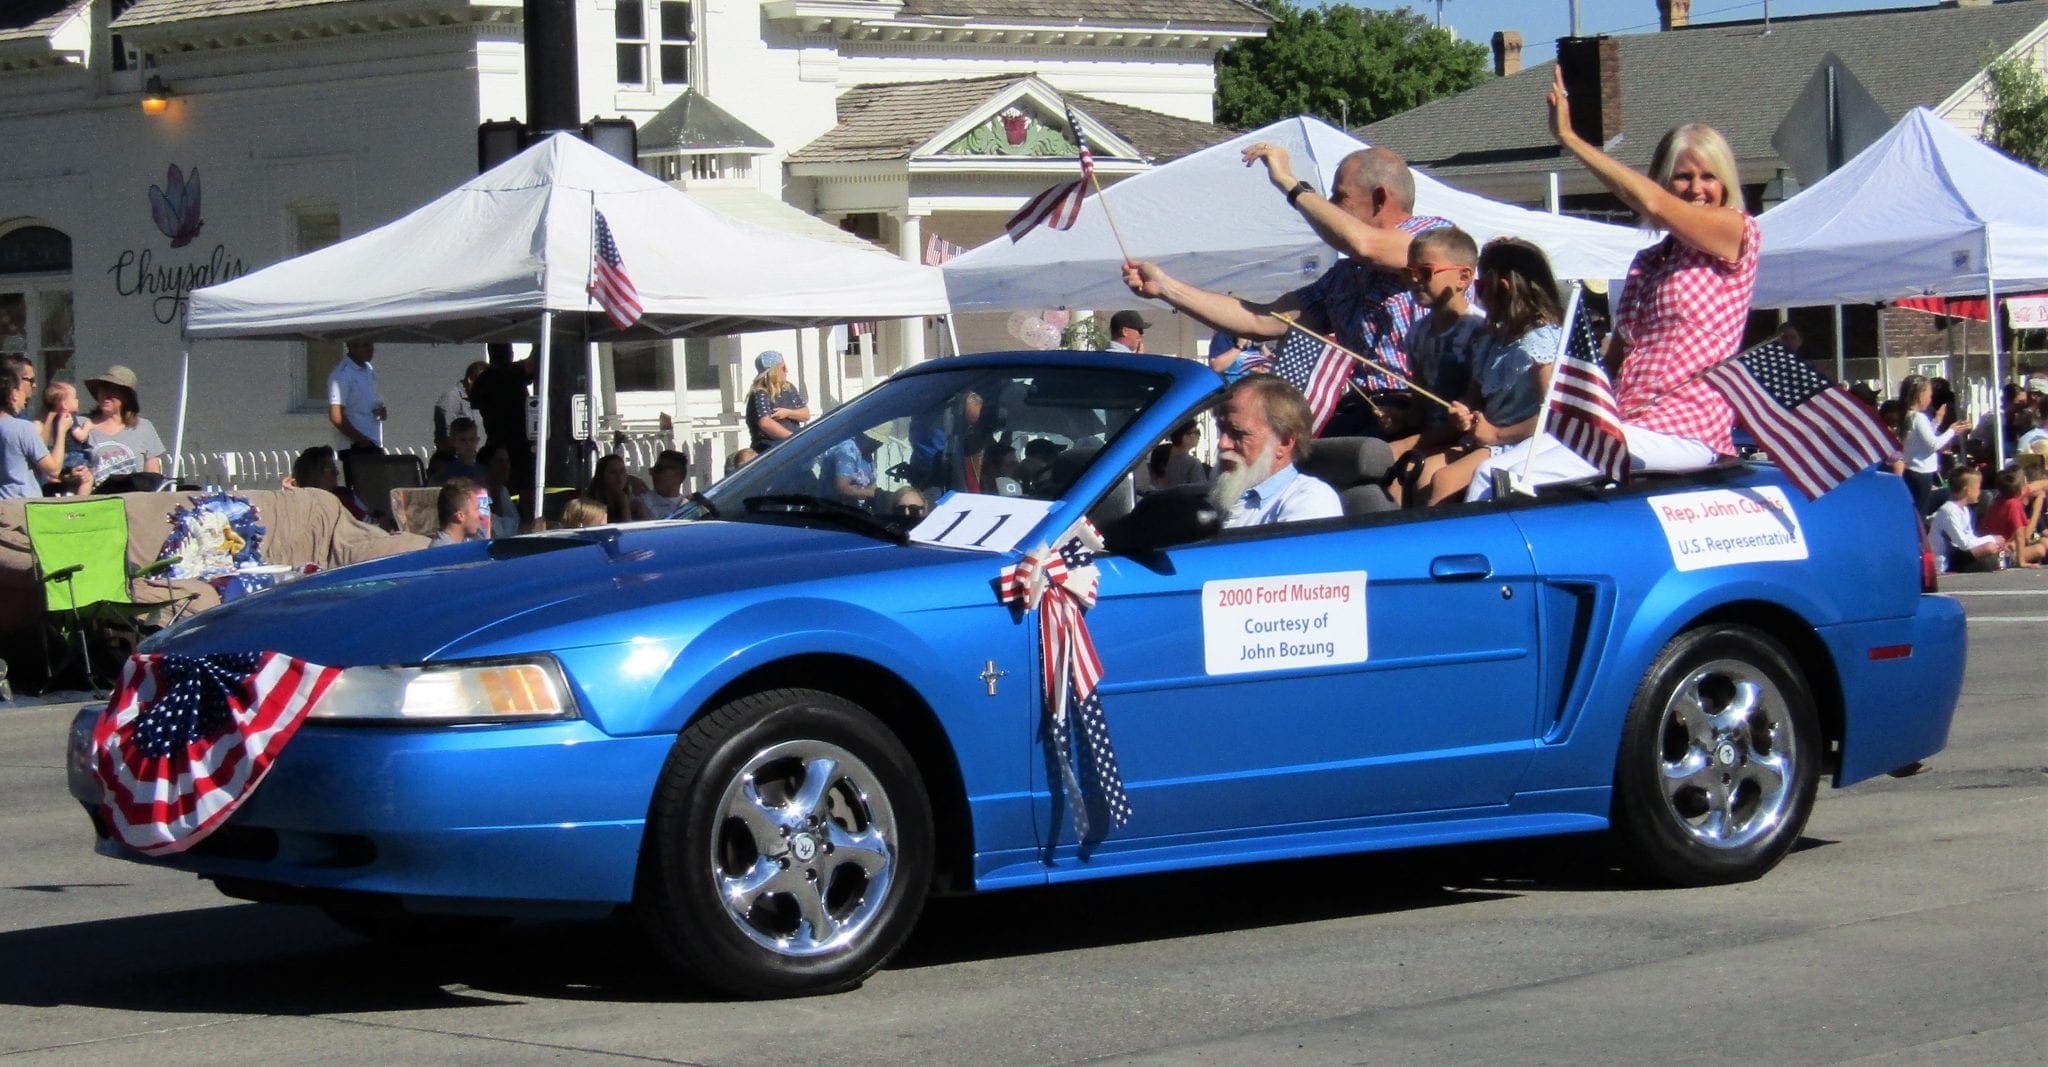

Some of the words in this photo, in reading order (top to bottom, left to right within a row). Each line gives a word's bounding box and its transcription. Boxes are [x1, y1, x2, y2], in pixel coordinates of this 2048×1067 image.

[107, 244, 250, 324] Chrysalis
[1662, 506, 1700, 524] Rep.
[1700, 500, 1739, 518] John
[928, 509, 1013, 547] 11
[1678, 538, 1705, 555] U.S.
[1706, 530, 1797, 552] Representative
[1219, 588, 1253, 607] 2000
[1256, 584, 1288, 604] Ford
[1291, 584, 1351, 603] Mustang
[1244, 617, 1309, 634] Courtesy
[1313, 612, 1329, 629] of
[1240, 643, 1276, 661] John
[1280, 641, 1335, 658] Bozung
